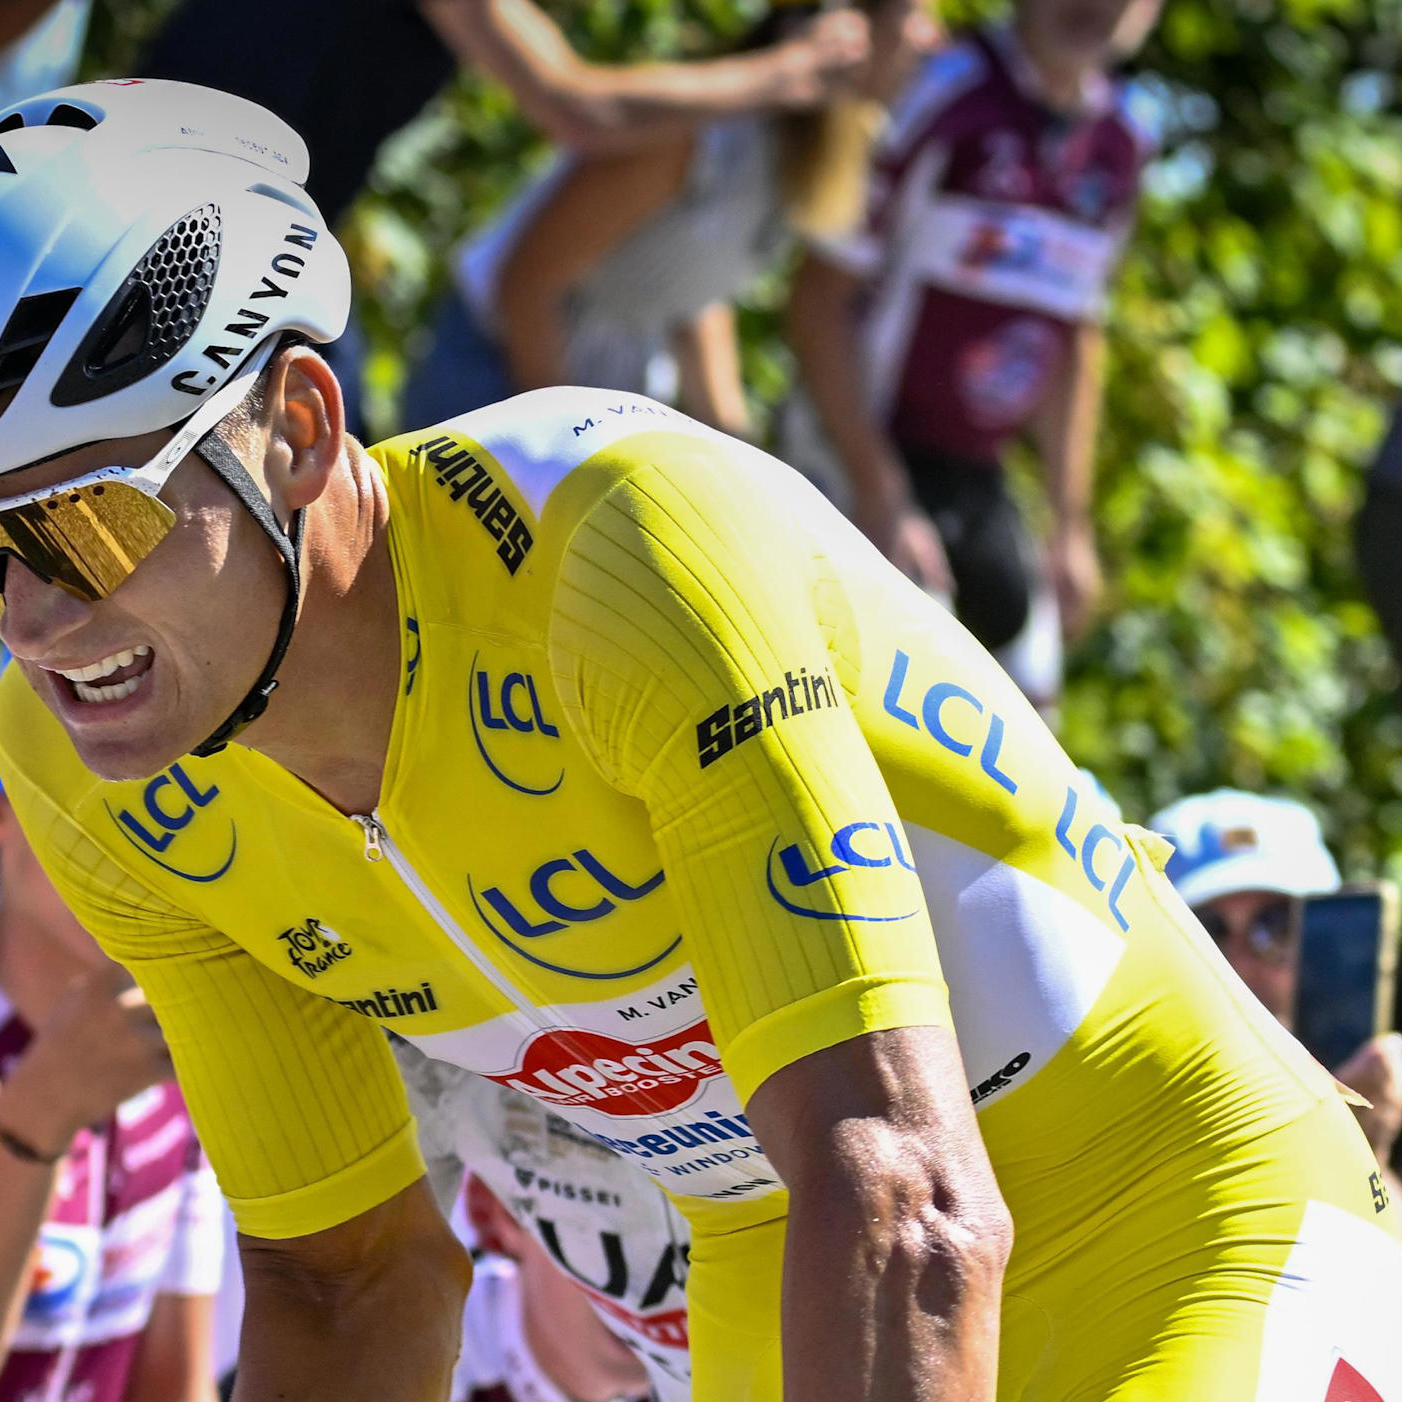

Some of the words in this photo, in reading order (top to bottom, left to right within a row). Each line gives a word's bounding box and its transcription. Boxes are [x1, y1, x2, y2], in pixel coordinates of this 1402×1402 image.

[170, 222, 319, 396] CANYON
[409, 435, 535, 578] Santini
[476, 671, 560, 739] LCL
[696, 666, 838, 769] Santini
[883, 648, 1018, 796] LCL
[118, 762, 220, 853] LCL
[481, 847, 666, 938] LCL
[778, 821, 918, 888] LCL
[1055, 785, 1139, 933] LCL
[324, 982, 439, 1019] antini
[616, 1005, 649, 1022] M.
[647, 976, 699, 1010] VAN
[506, 1038, 721, 1101] Alpecin
[606, 1064, 724, 1099] BOOSTE
